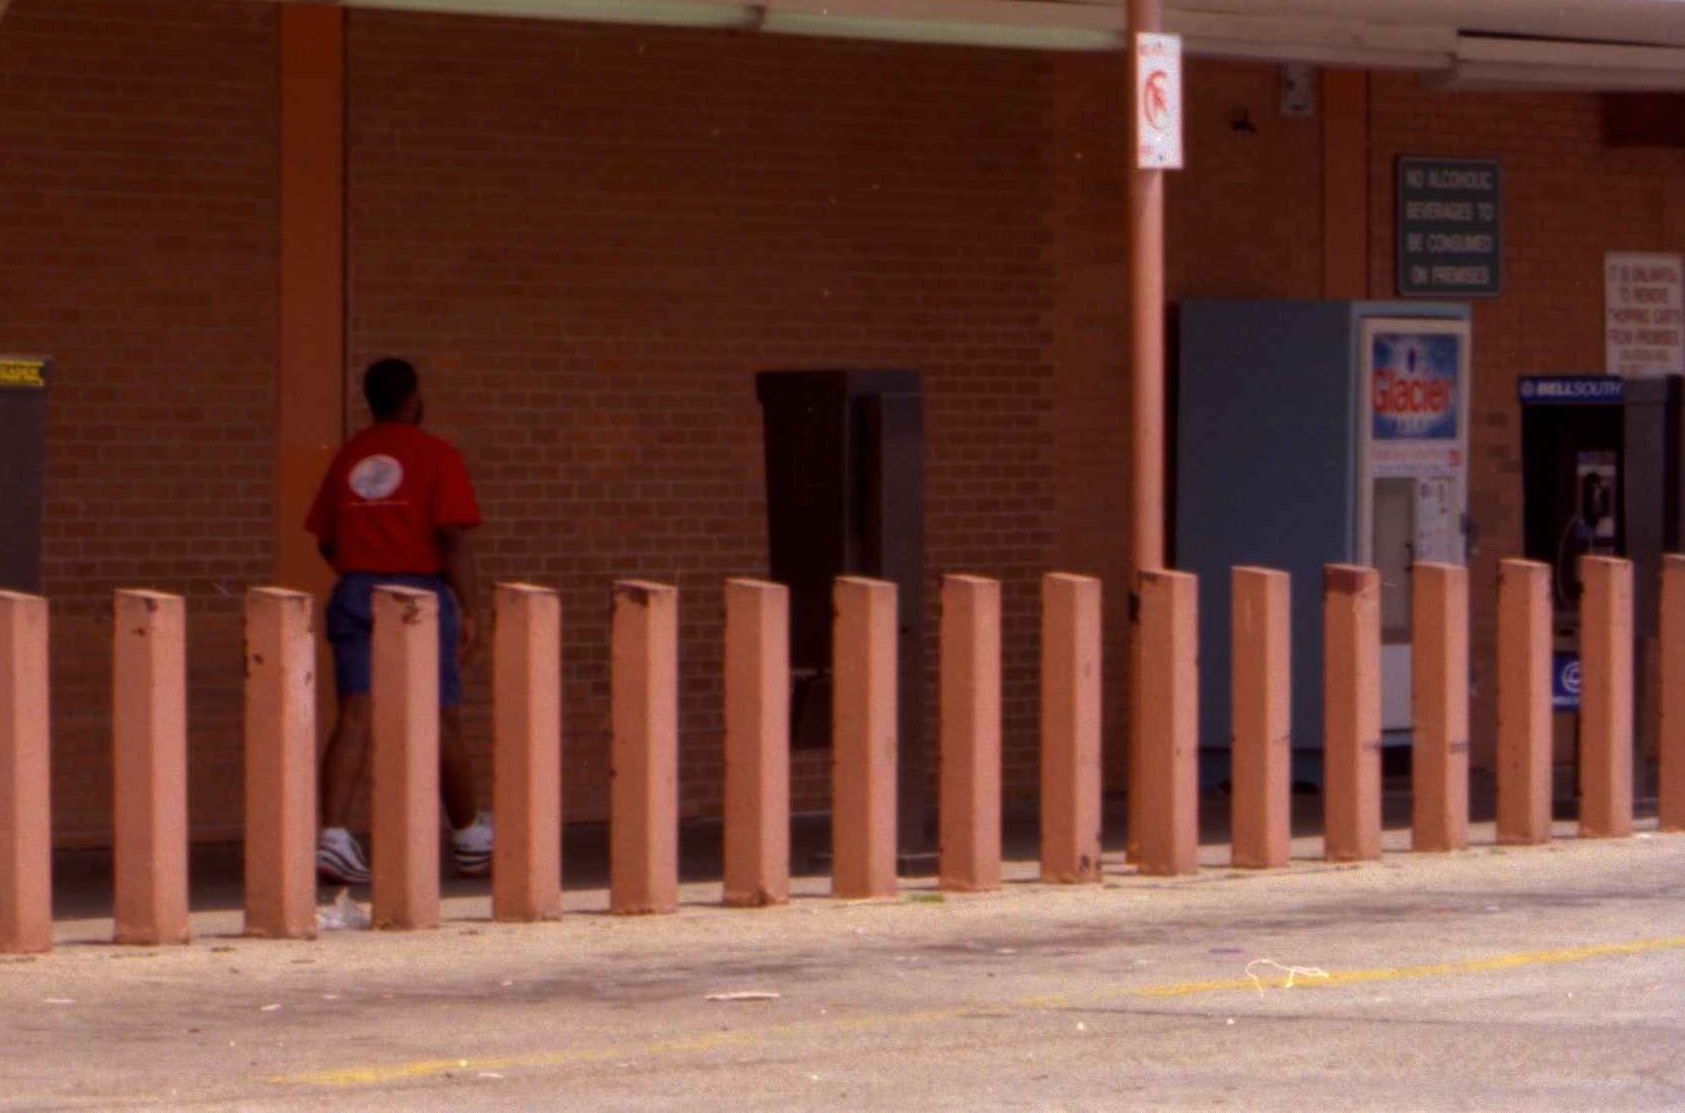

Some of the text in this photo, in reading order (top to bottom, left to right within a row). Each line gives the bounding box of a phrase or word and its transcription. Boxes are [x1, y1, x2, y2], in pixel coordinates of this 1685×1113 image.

[1406, 170, 1493, 189] NO ALCOHOLIC
[1405, 202, 1494, 221] BEVERAGES TO
[1407, 233, 1493, 253] BE CONSUMED
[1412, 265, 1490, 285] ON PREMISES
[1373, 368, 1453, 414] Glacier
[1536, 380, 1621, 396] BELLSOUTH
